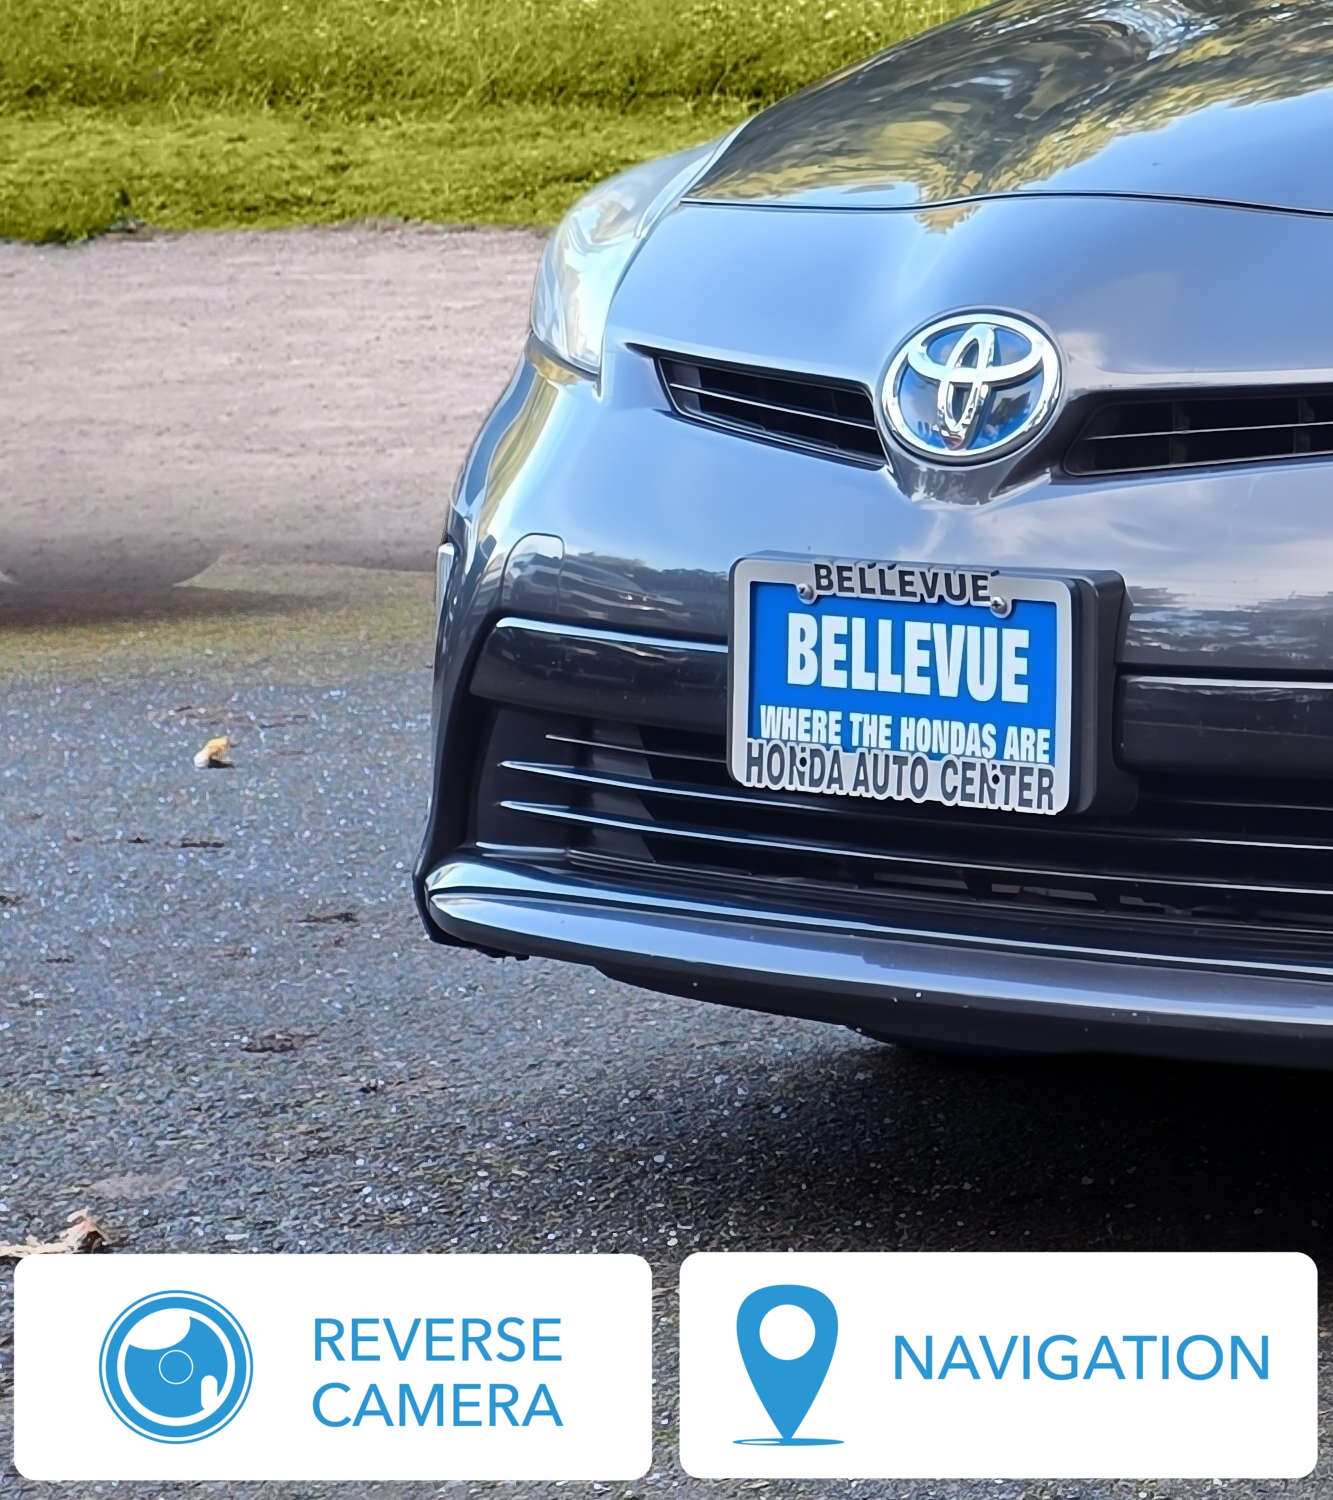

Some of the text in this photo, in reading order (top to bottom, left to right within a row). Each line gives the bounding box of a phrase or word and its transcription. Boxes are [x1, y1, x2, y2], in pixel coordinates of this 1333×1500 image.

[813, 563, 993, 603] BELLEVUE
[787, 612, 1030, 704] BELLEVUE
[759, 704, 1051, 764] WHERE THE HONDAS ARE
[745, 741, 1054, 811] HONDA AUTO CENTER
